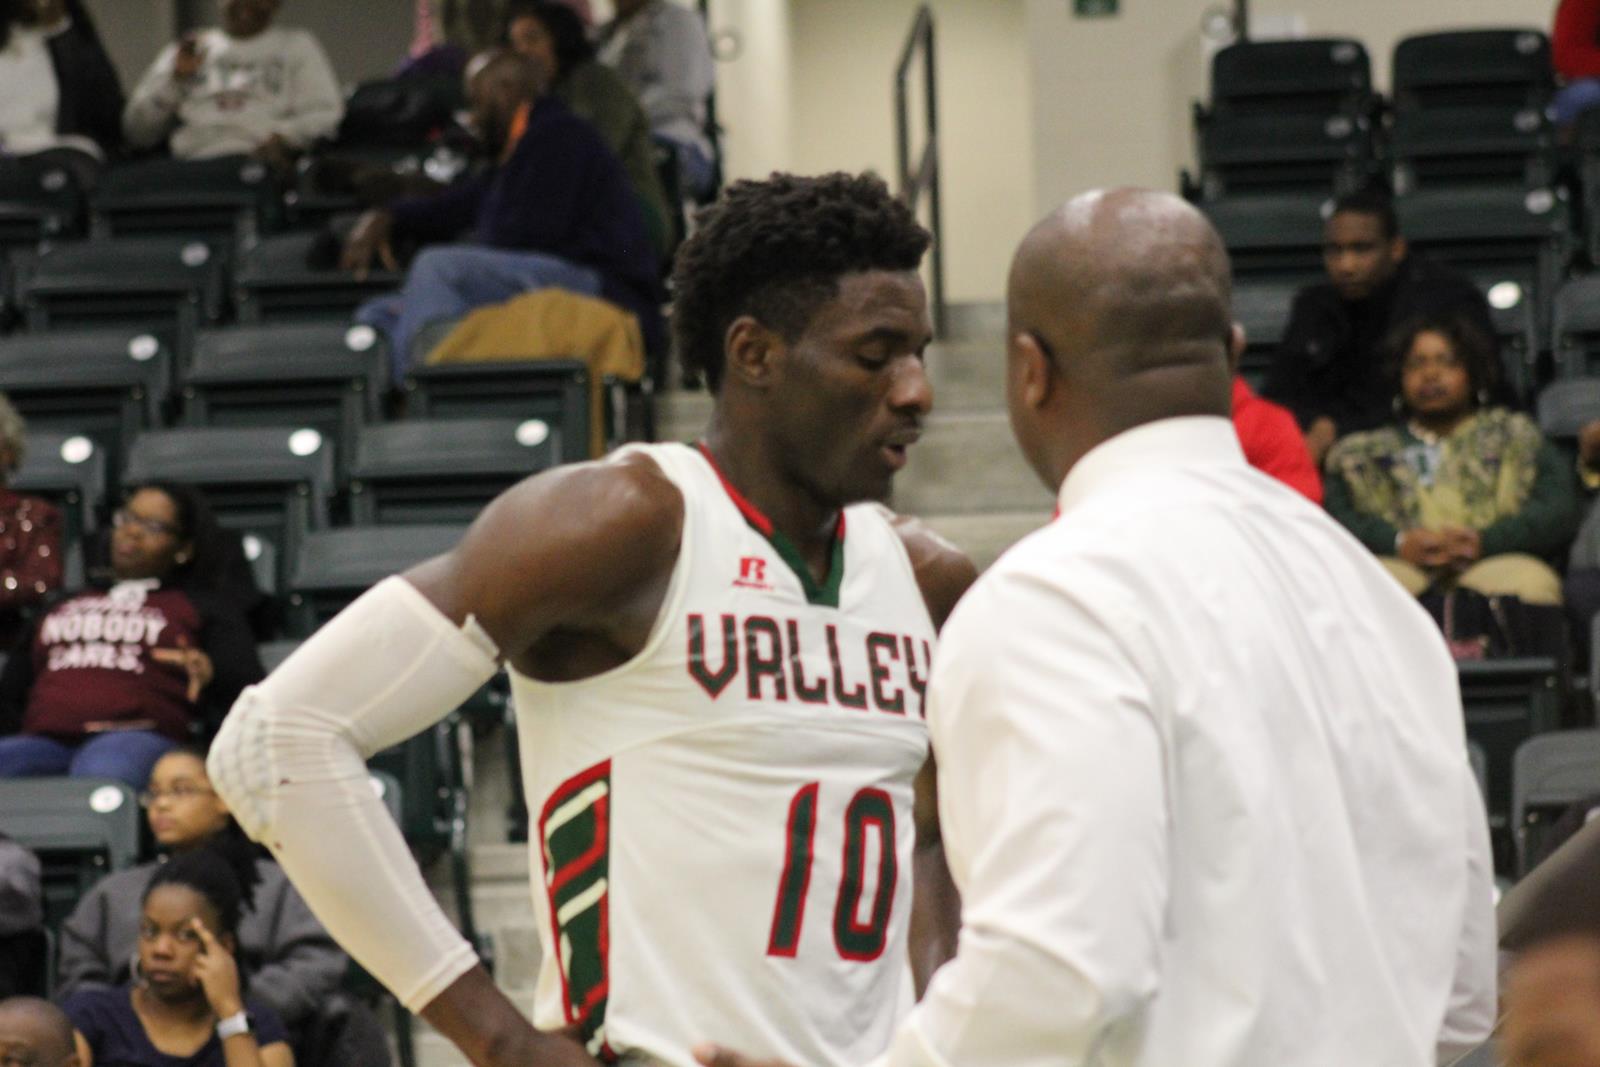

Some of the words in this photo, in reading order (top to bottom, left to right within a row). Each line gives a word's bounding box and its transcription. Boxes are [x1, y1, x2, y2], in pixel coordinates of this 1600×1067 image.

[41, 613, 167, 646] NOBODY
[687, 613, 931, 719] VALLEY
[766, 782, 898, 962] 10
